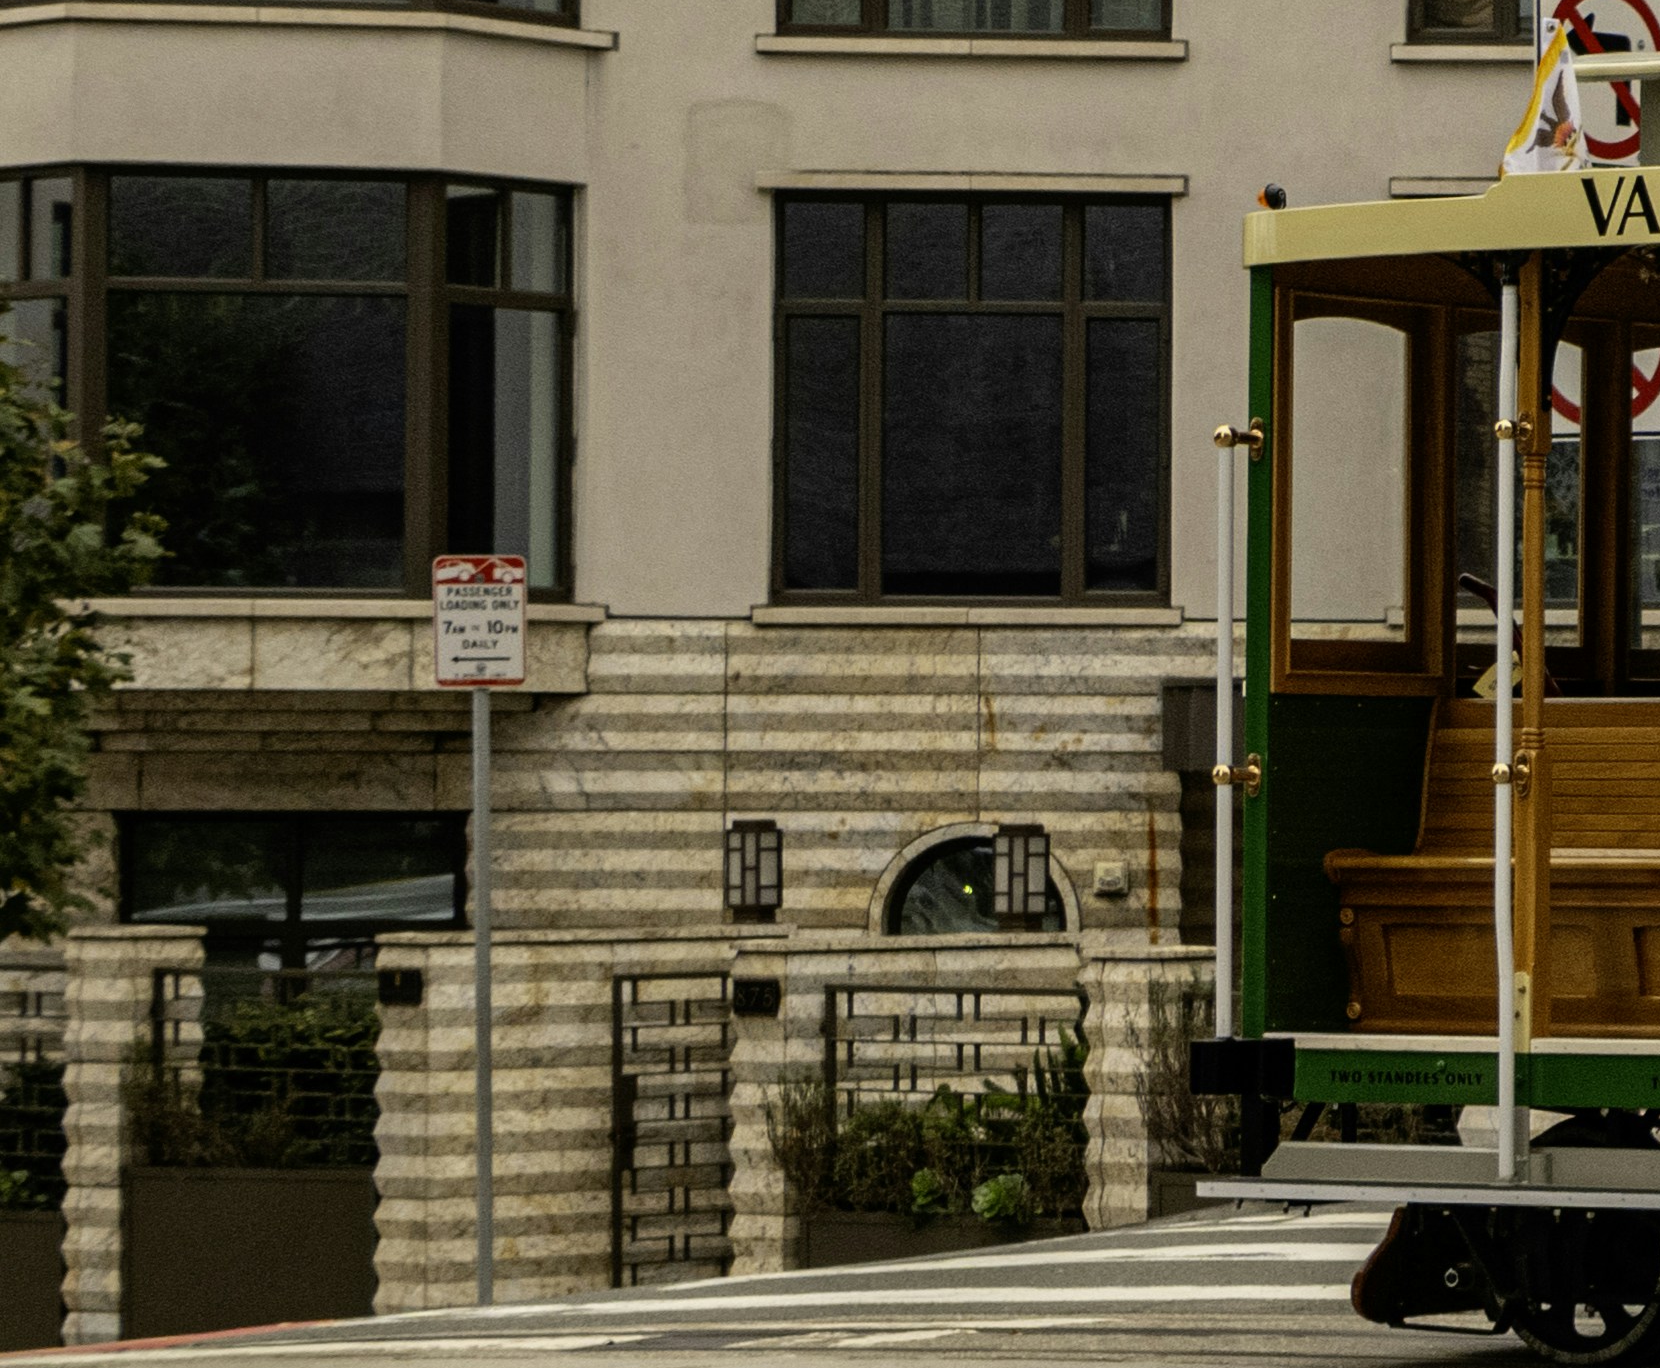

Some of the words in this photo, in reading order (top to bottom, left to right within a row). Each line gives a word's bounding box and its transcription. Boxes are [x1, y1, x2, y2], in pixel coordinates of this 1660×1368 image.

[446, 586, 513, 598] PASSENGER
[440, 599, 487, 611] LOADING
[491, 599, 520, 611] ONLY
[462, 639, 498, 649] DAILY
[1330, 1070, 1362, 1083] TWO
[1368, 1071, 1440, 1085] STANDEES
[1445, 1072, 1483, 1086] ONLY
